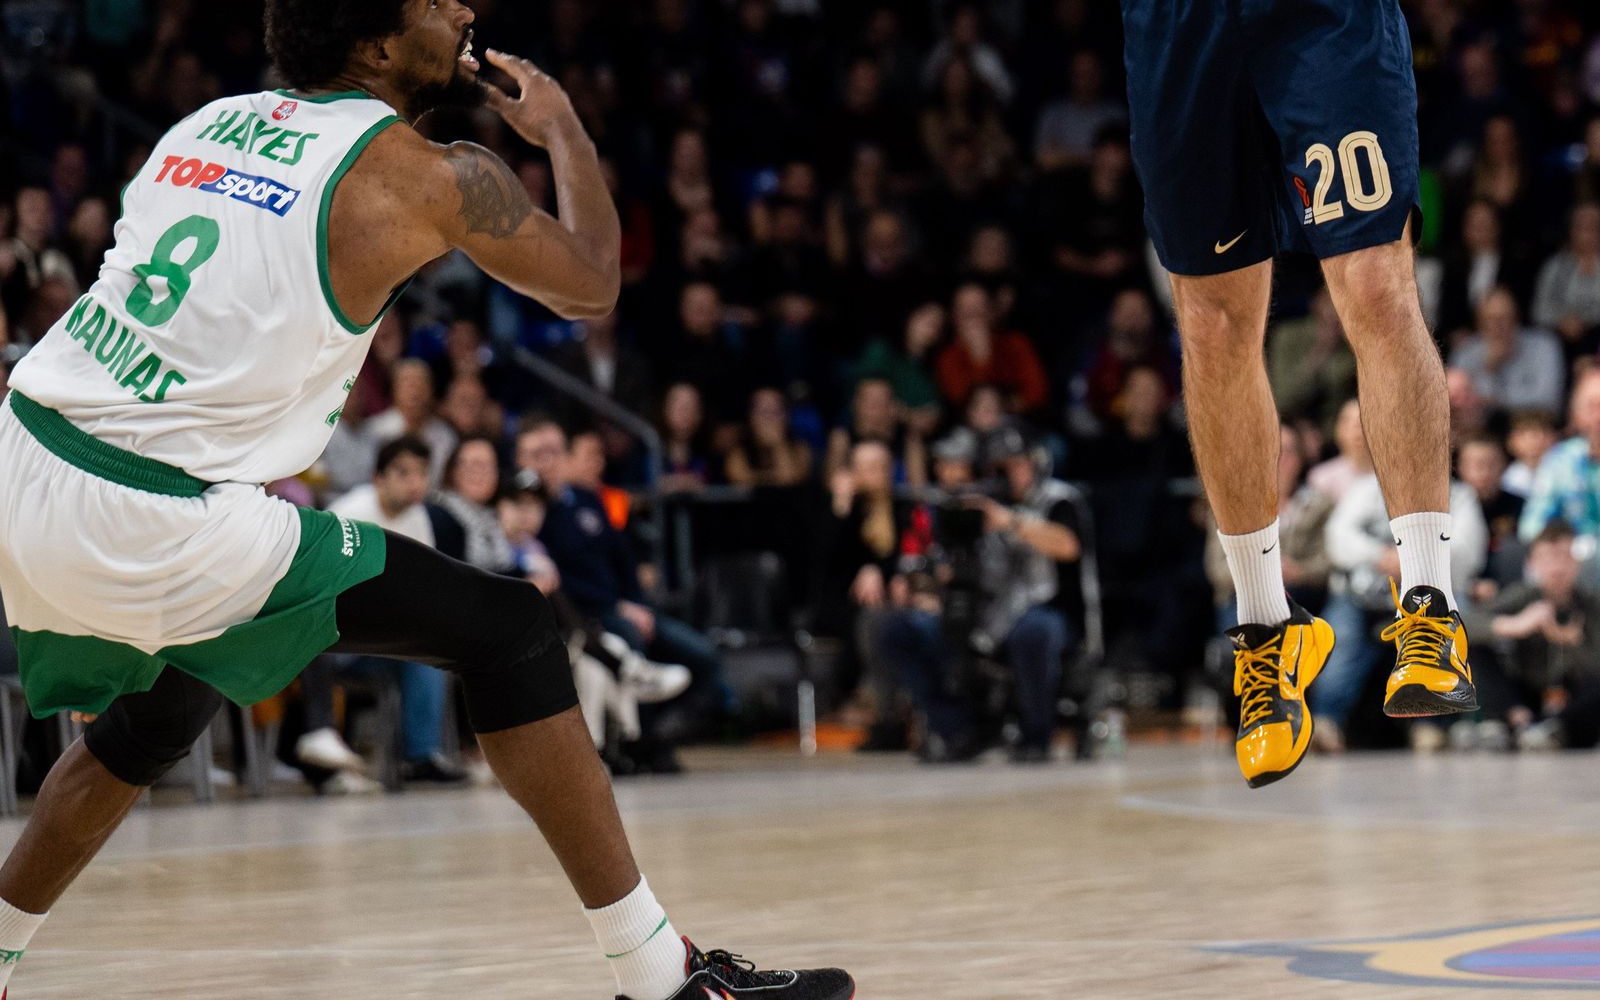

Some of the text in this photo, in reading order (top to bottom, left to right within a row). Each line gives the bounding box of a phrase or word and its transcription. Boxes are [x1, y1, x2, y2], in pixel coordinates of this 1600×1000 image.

[196, 110, 320, 167] HAYES
[1305, 130, 1393, 225] 20
[125, 214, 221, 327] 8
[64, 295, 187, 404] KAUNAS
